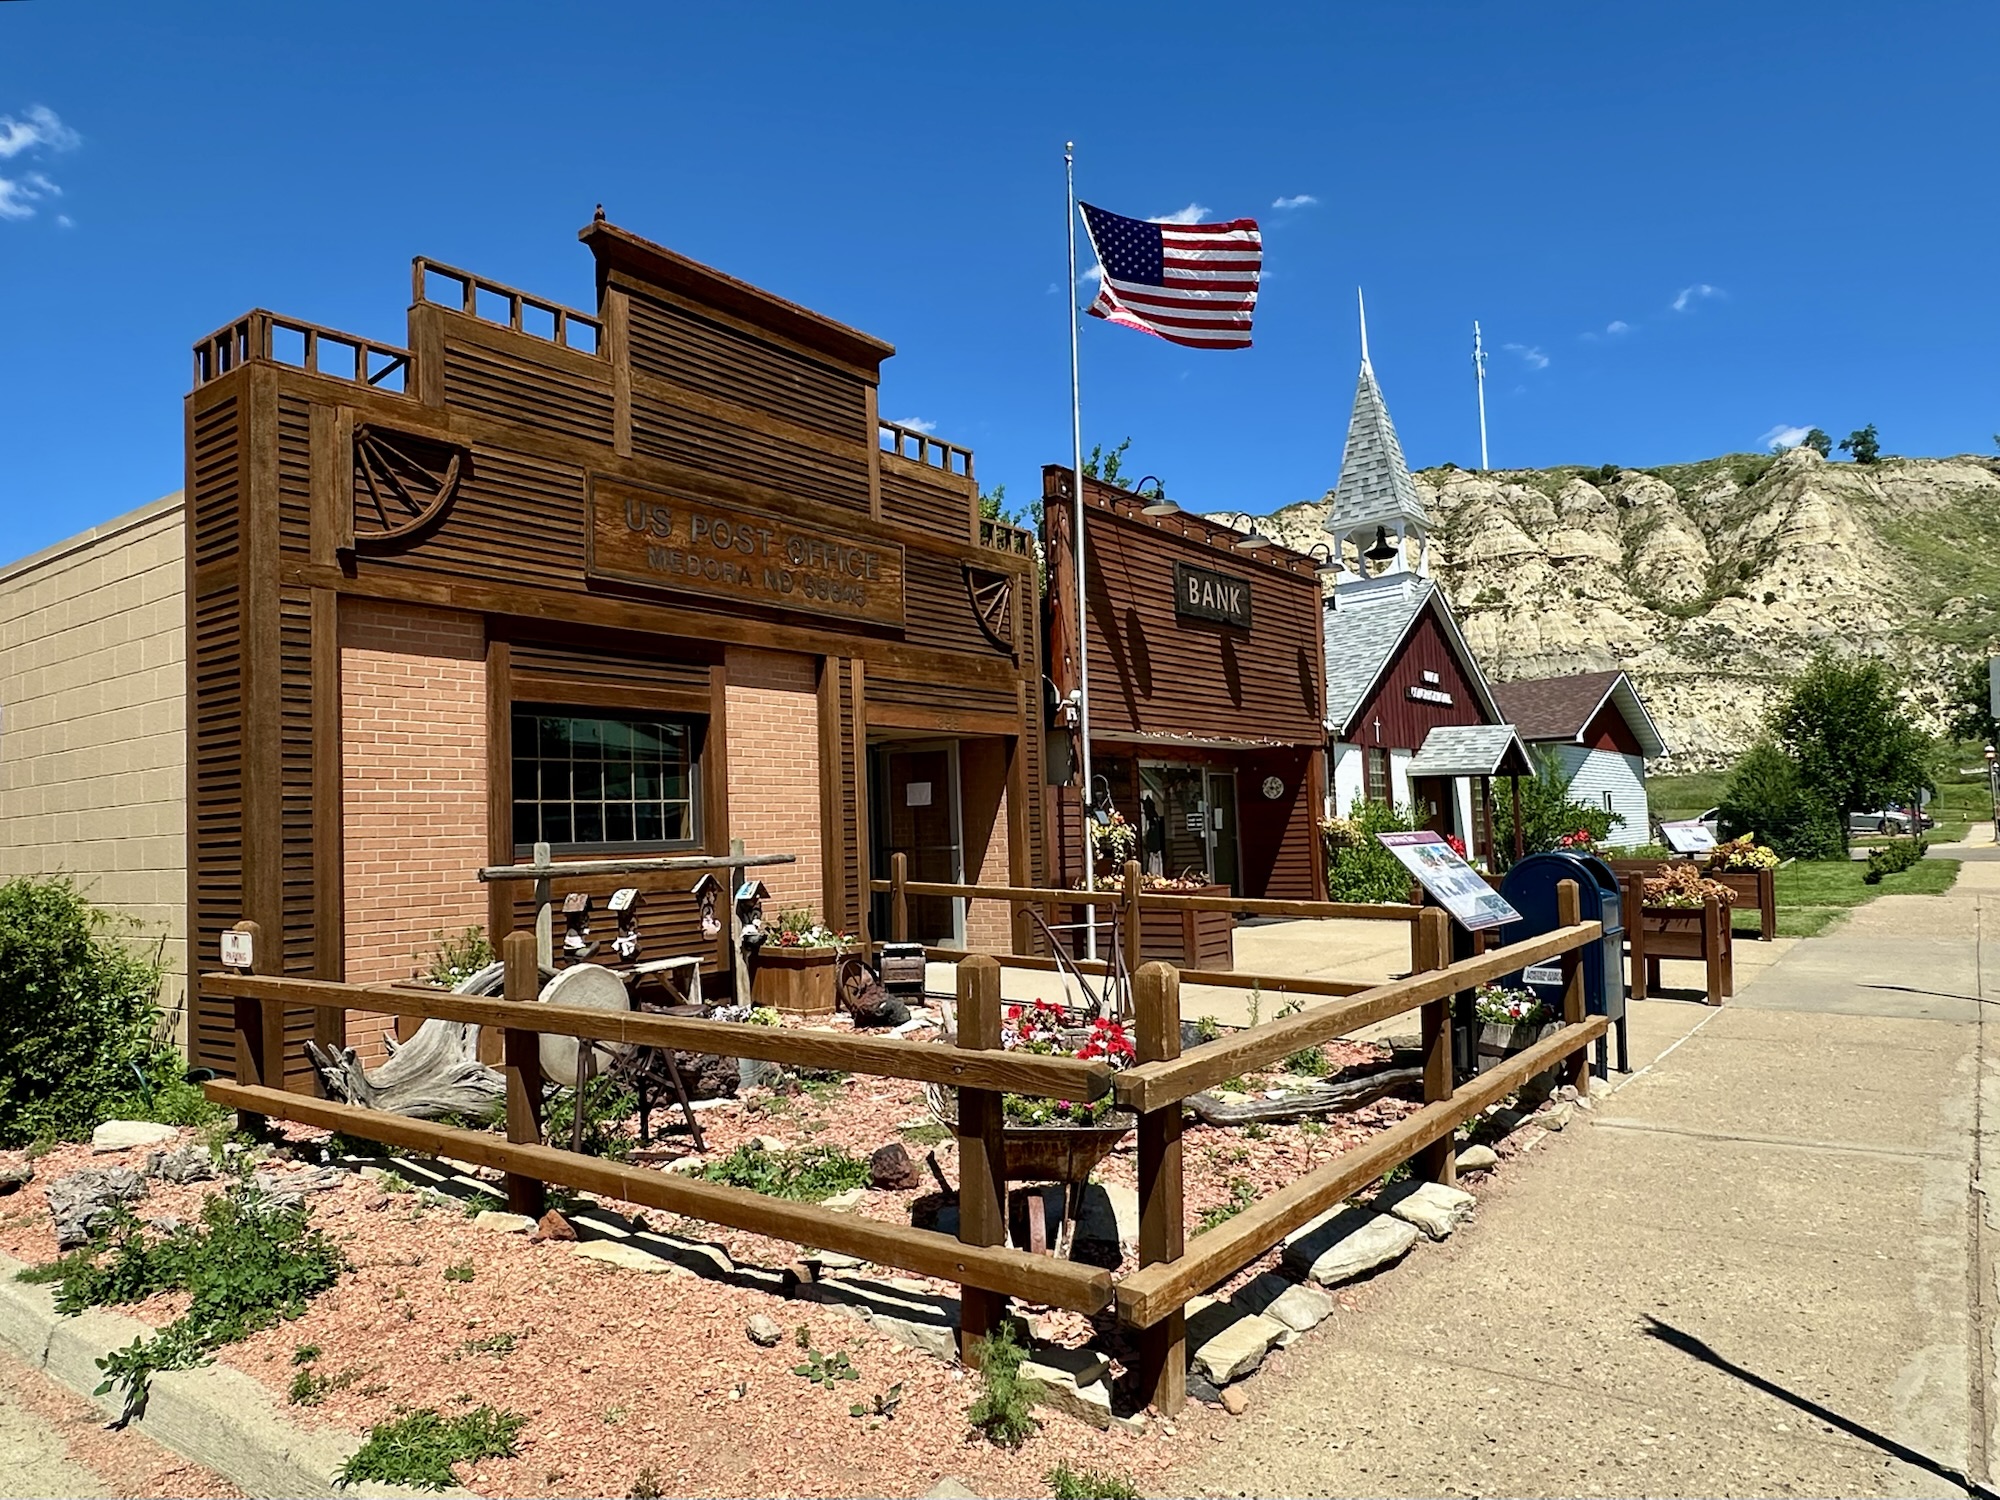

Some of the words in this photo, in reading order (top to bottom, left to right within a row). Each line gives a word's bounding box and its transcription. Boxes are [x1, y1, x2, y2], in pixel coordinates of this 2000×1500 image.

[624, 499, 673, 537] US
[690, 513, 774, 557] POST
[786, 534, 880, 581] OFFICE
[647, 547, 753, 588] MEDORA
[763, 567, 794, 594] ND
[803, 576, 866, 608] 58645
[1188, 576, 1242, 615] BANK
